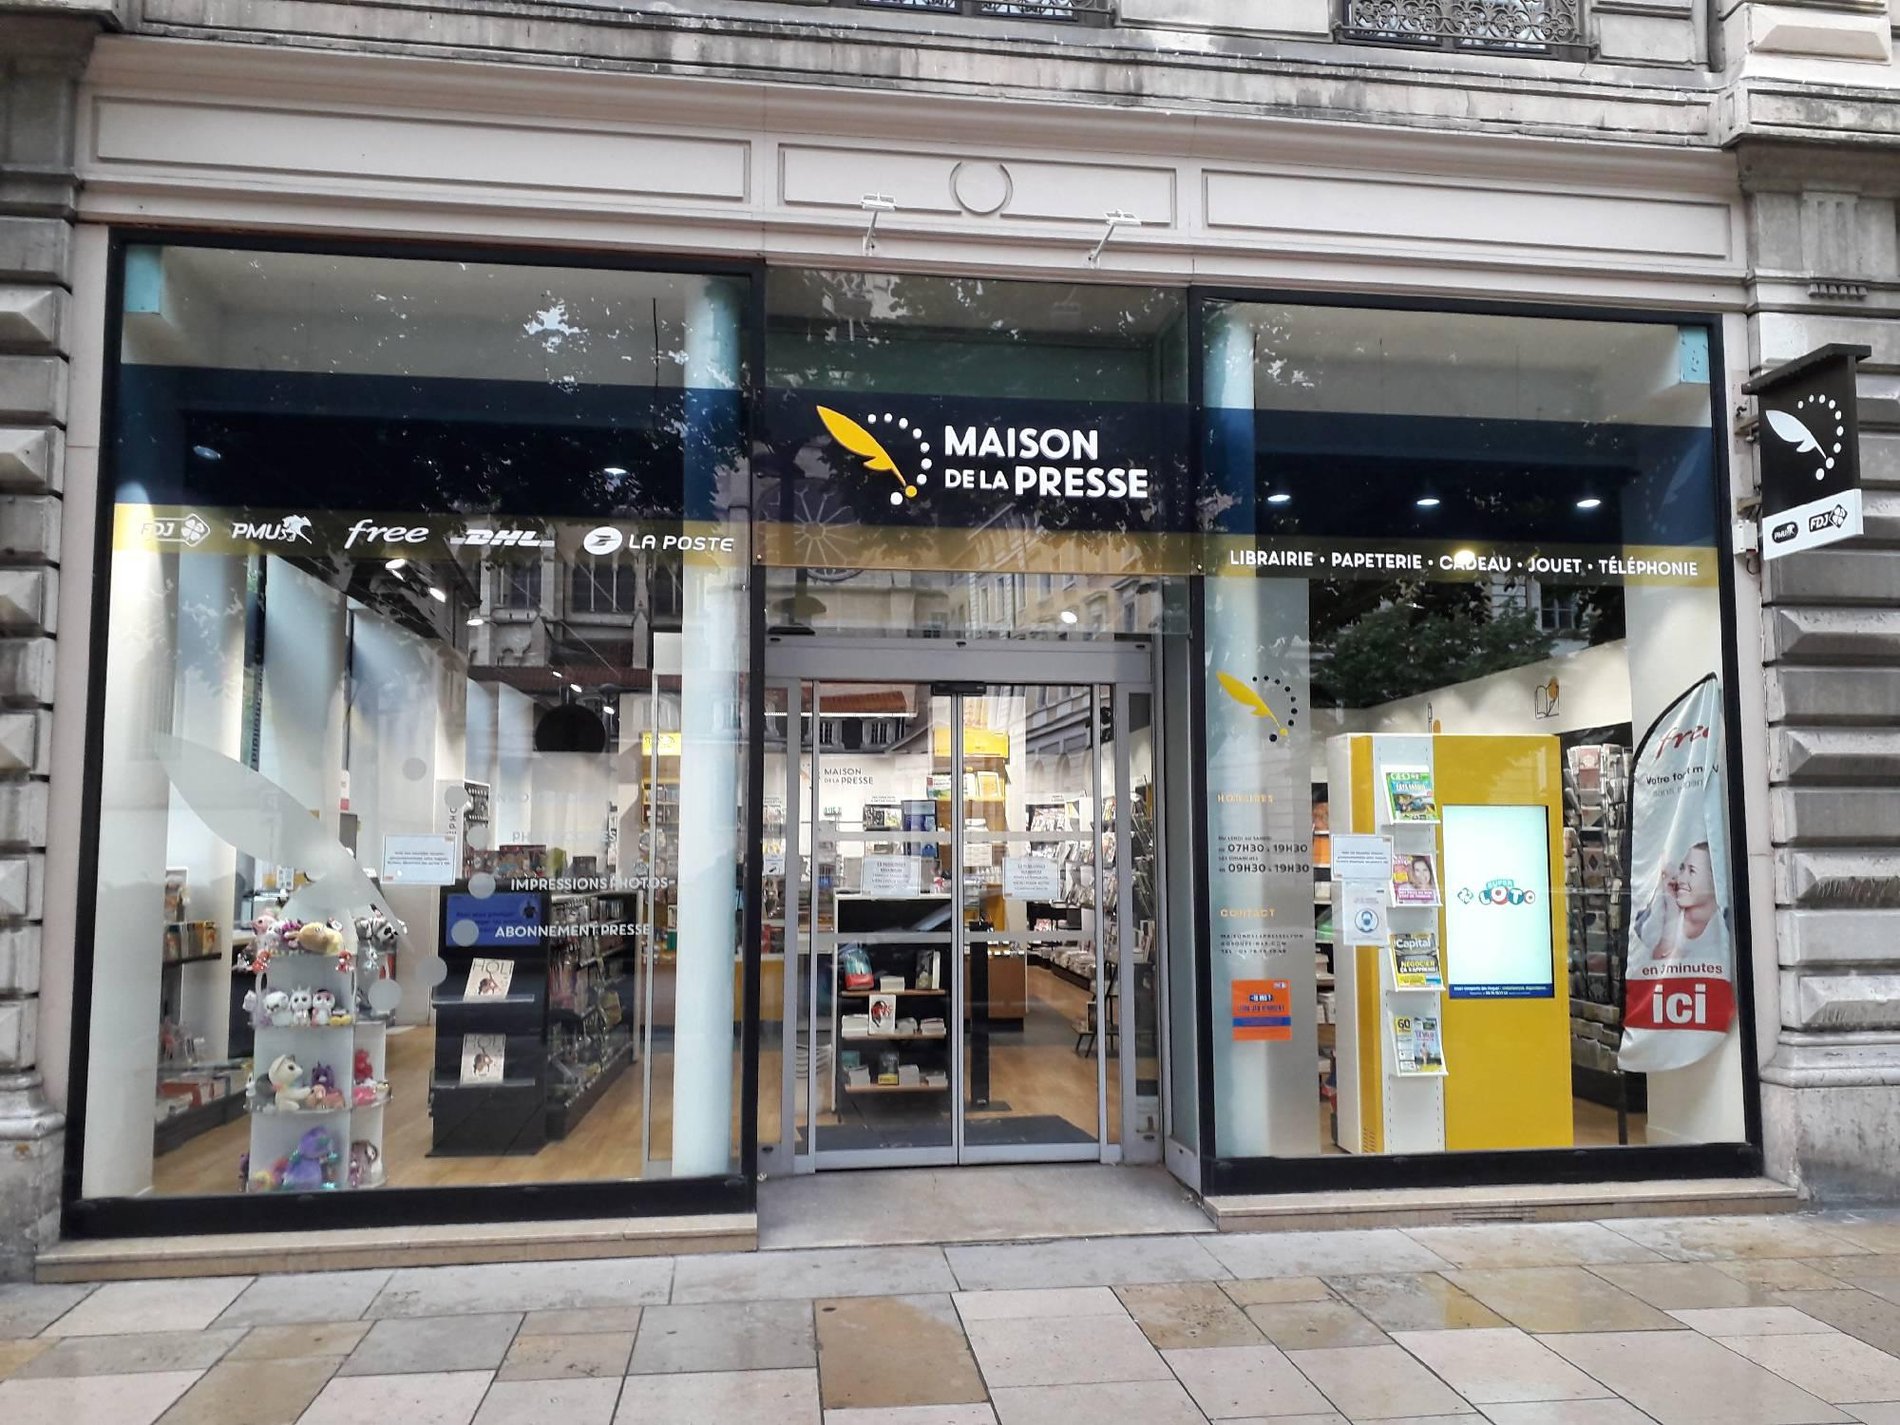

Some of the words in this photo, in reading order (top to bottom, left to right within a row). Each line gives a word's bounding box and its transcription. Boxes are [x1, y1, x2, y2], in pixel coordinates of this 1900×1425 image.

[944, 425, 1098, 460] MAISON
[944, 468, 974, 489] DE
[980, 470, 1009, 490] LA
[1015, 465, 1148, 498] PRESSE
[141, 522, 175, 537] FDJ
[1810, 514, 1829, 530] FDJ
[232, 522, 281, 540] PMU
[344, 519, 429, 549] free
[452, 529, 553, 547] DHL
[629, 534, 656, 549] LA
[662, 535, 734, 551] POSTE
[1230, 550, 1313, 567] LIBRAIRIE
[1331, 552, 1422, 570] PAPETERIE
[1439, 555, 1511, 572] CADEAU
[1528, 556, 1581, 574] JOUET
[1599, 557, 1698, 576] TÉLÉPHONIE
[841, 776, 874, 785] PRESSE
[1646, 775, 1670, 785] Votre
[1228, 844, 1264, 853] 07H30
[1273, 844, 1308, 853] 19H30
[1228, 864, 1266, 873] 09H30
[1275, 864, 1310, 873] 19H30
[511, 876, 607, 891] IMPRESSIONS
[610, 877, 668, 890] PHOTOS
[1479, 886, 1535, 905] LOTO
[495, 924, 596, 938] ABONNEMENT
[600, 923, 650, 936] PRESSE
[1396, 938, 1431, 950] Capital
[1642, 966, 1658, 976] en
[1667, 963, 1723, 974] minutes
[1653, 983, 1706, 1024] ici
[1398, 1018, 1411, 1030] 60
